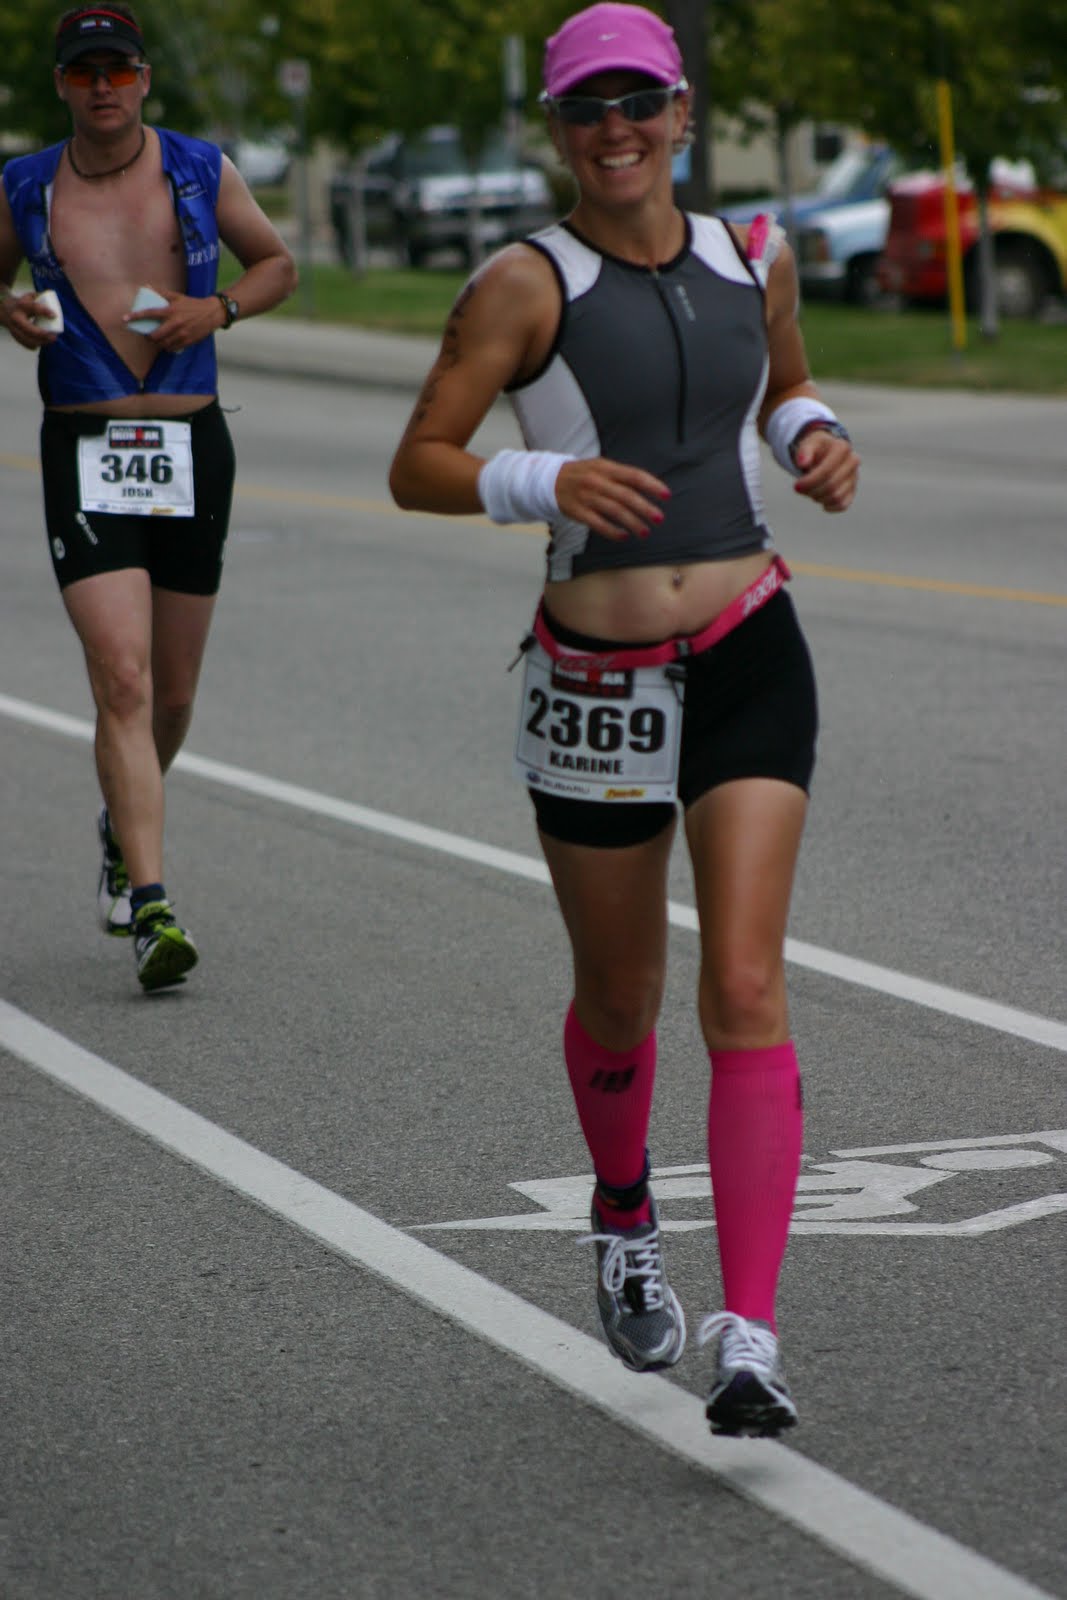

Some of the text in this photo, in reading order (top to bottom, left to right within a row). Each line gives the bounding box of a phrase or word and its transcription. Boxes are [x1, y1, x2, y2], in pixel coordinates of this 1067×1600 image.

[100, 454, 174, 484] 346
[526, 687, 666, 754] 2369
[549, 751, 624, 775] KARINE
